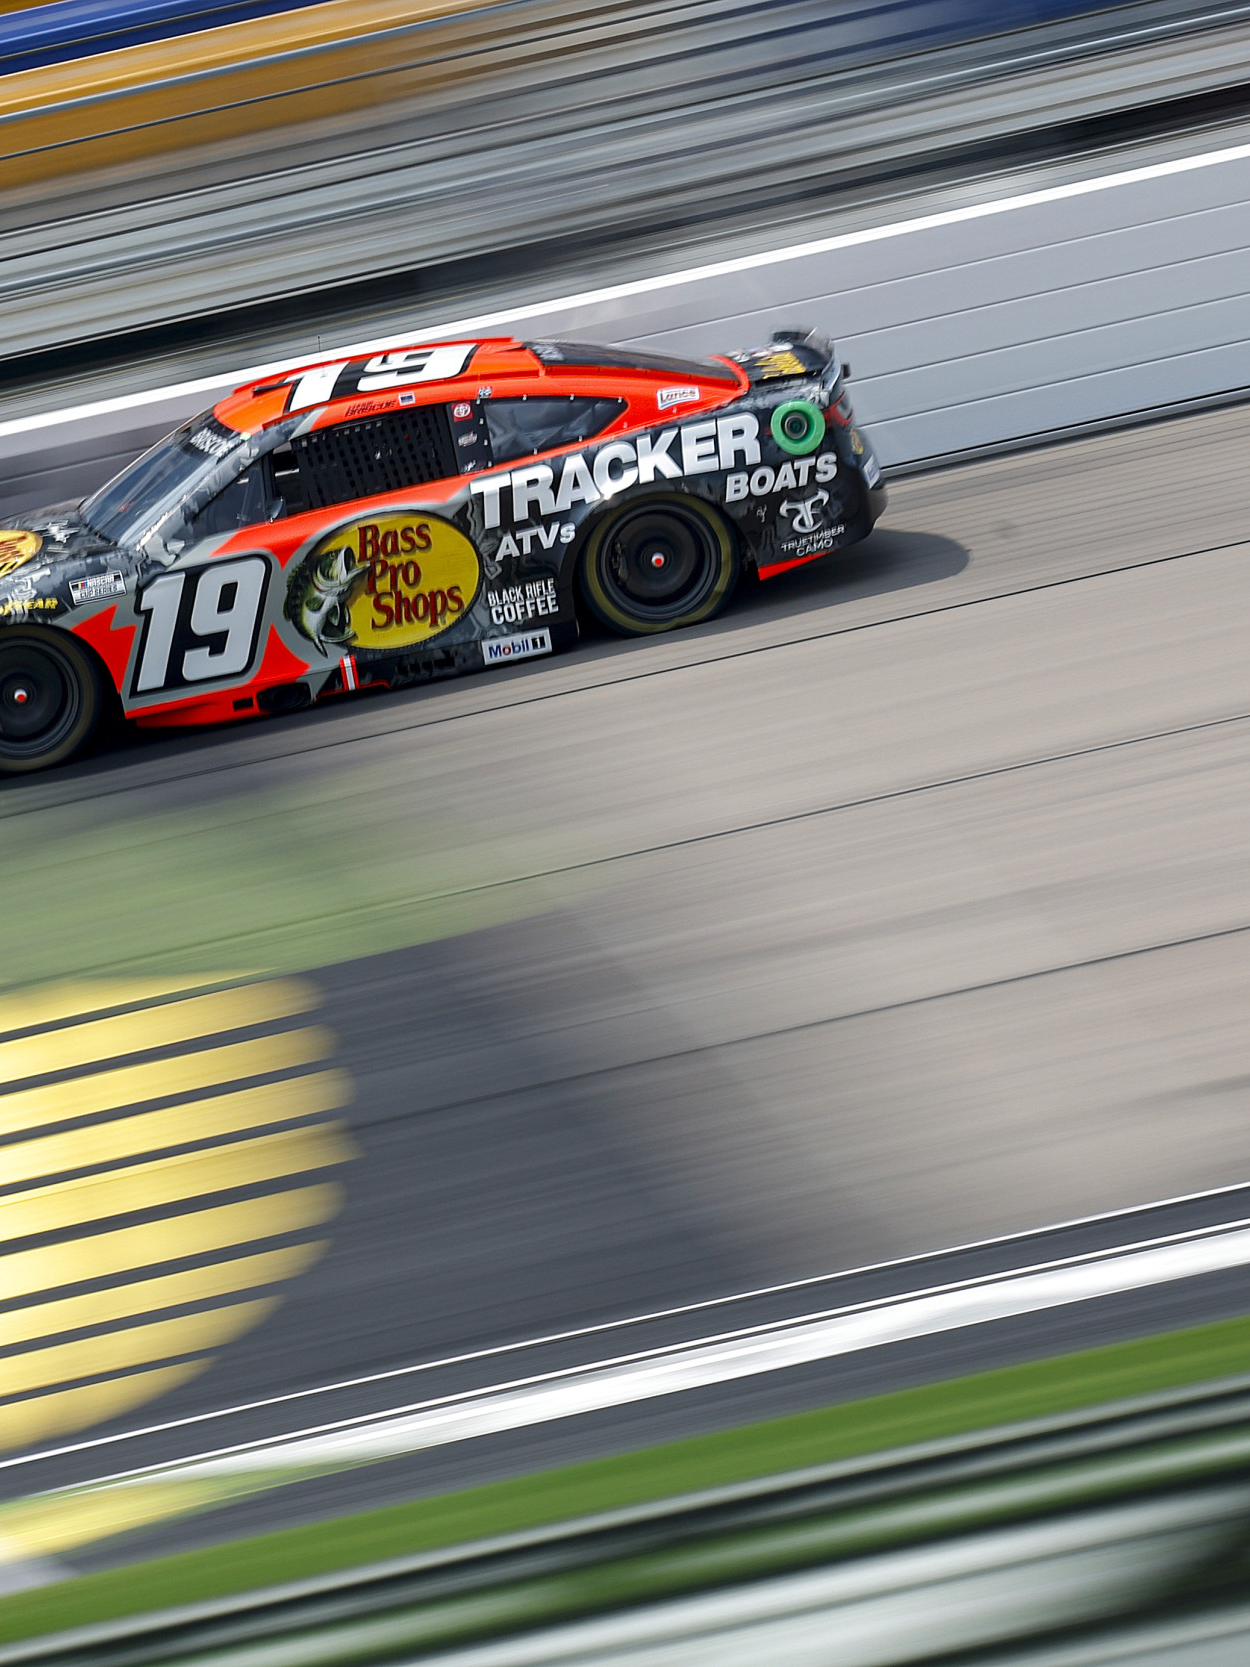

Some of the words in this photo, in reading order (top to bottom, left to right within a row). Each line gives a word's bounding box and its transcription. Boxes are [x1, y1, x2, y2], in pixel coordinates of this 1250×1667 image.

[283, 343, 477, 412] 19
[659, 388, 697, 403] Lance
[469, 412, 762, 529] TRACKER
[726, 452, 838, 503] BOATS
[357, 524, 432, 562] Bass
[495, 521, 576, 562] ATVs
[796, 537, 833, 557] CAMO
[366, 559, 421, 594] Pro
[487, 584, 524, 607] BLACK
[526, 577, 555, 599] RIFLE
[137, 558, 266, 692] 19
[371, 586, 464, 629] Shops
[491, 595, 559, 625] COFFEE
[488, 638, 530, 659] Mobil
